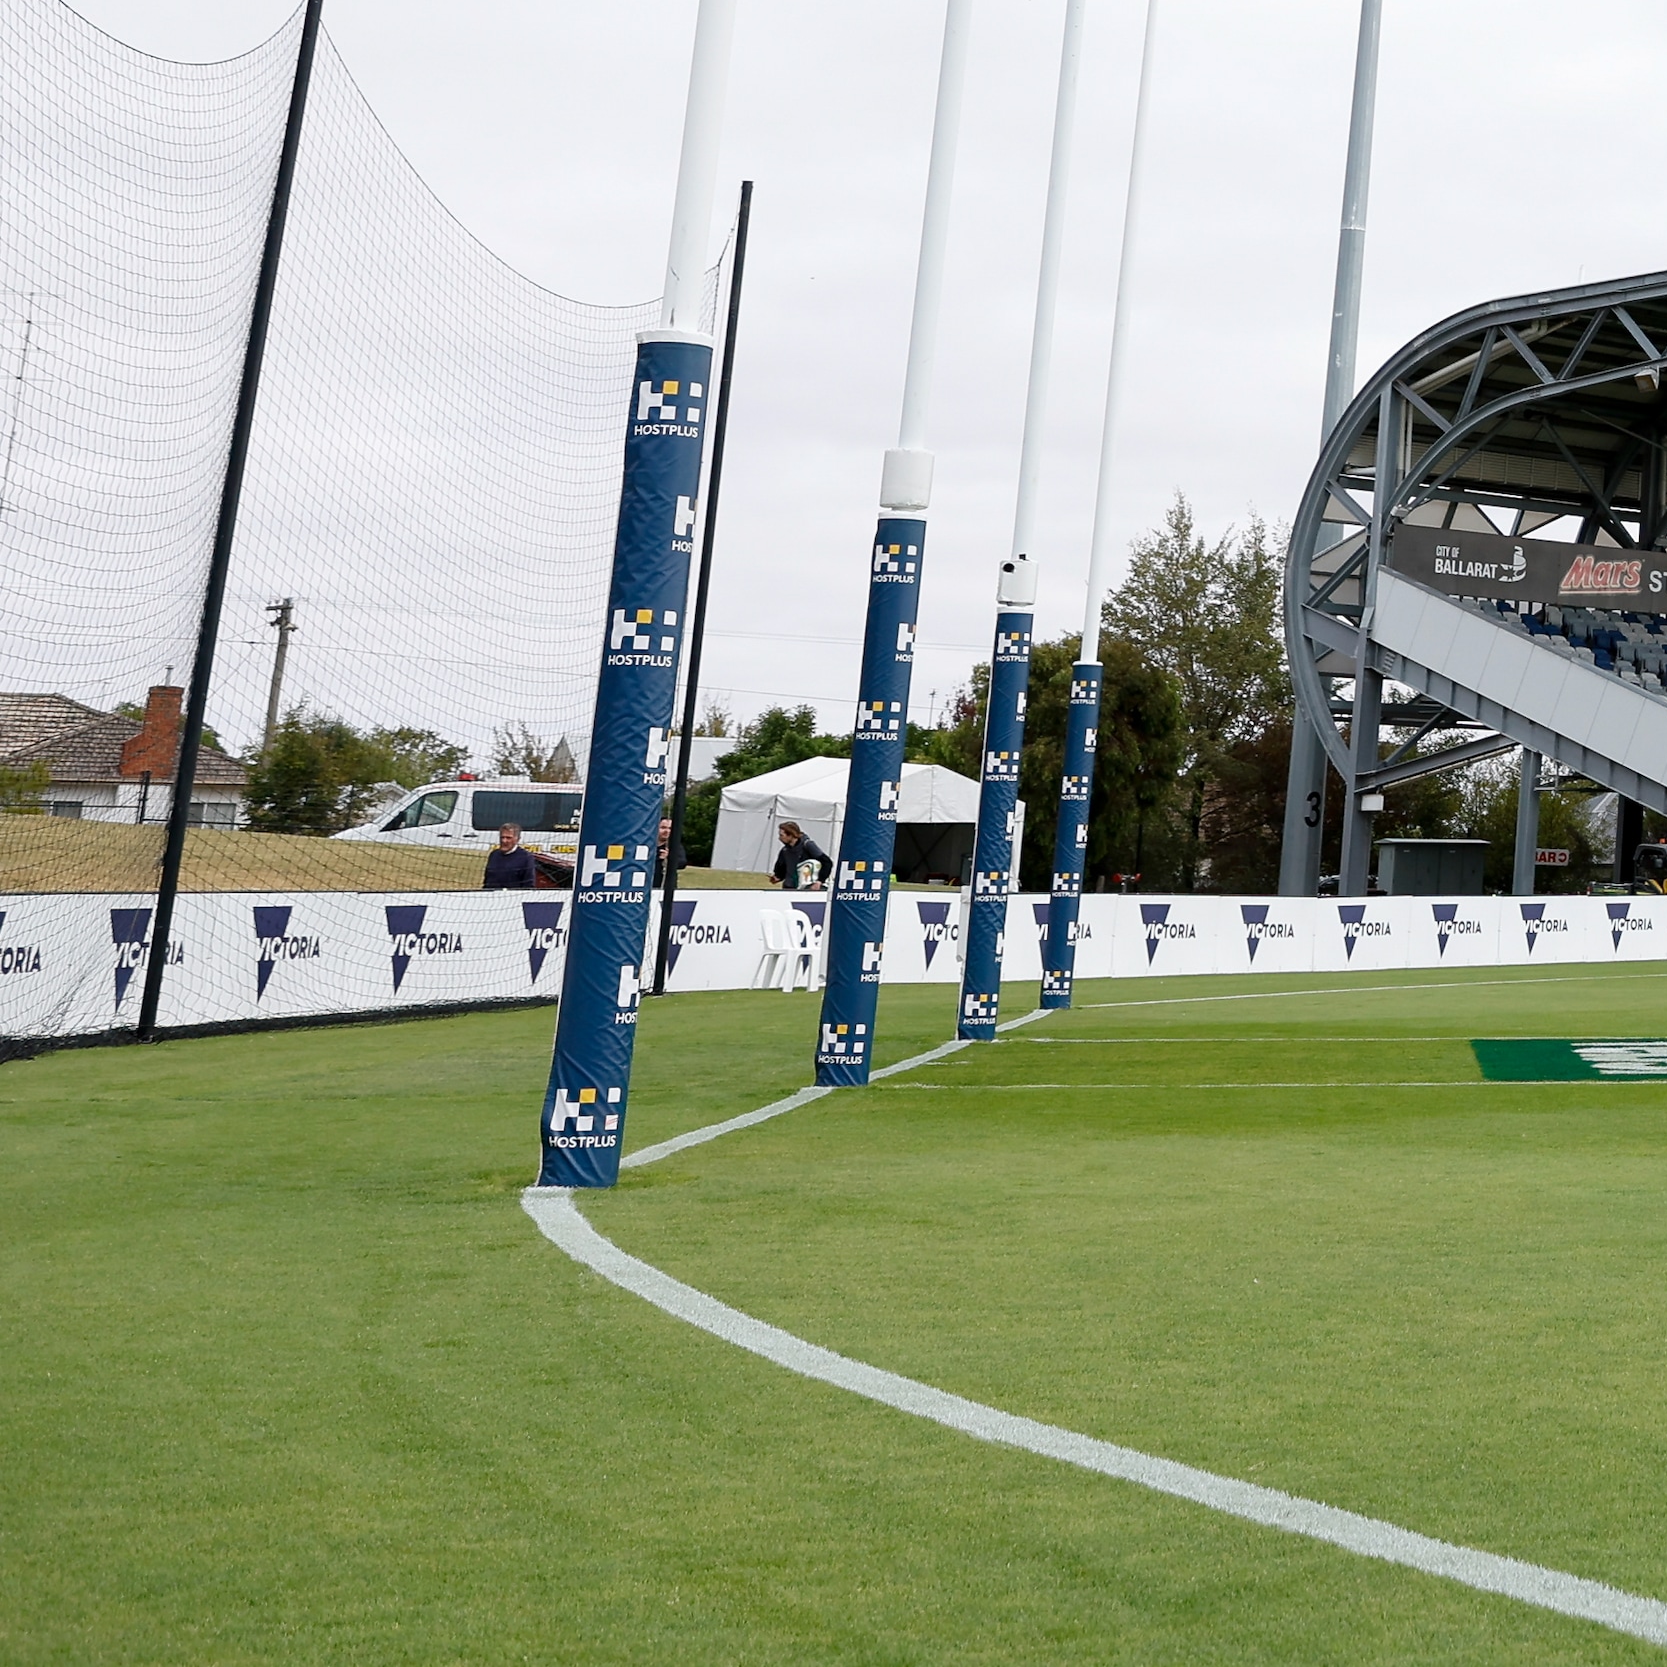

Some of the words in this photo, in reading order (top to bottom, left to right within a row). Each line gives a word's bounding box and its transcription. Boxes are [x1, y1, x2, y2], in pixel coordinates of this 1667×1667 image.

[634, 424, 698, 438] HOSTPLUS
[1436, 545, 1451, 557] CITY
[1451, 547, 1460, 558] OF
[1435, 559, 1498, 579] BALLARAT
[1561, 555, 1641, 590] Mars
[873, 574, 914, 584] HOSTPLUS
[608, 654, 672, 667] HOSTPLUS
[856, 732, 898, 741] HOSTPLUS
[1304, 791, 1321, 828] 3
[578, 891, 644, 904] HOSTPLUS
[836, 892, 881, 901] HOSTPLUS
[1143, 922, 1196, 940] VICTORIA
[1245, 922, 1294, 940] VICTORIA
[1342, 922, 1391, 938] VICTORIA
[1435, 920, 1482, 935] VICTORIA
[1522, 918, 1568, 934] VICTORIA
[1609, 918, 1653, 933] VICTORIA
[256, 935, 320, 962] VICTORIA
[388, 932, 463, 957] VICTORIA
[818, 1055, 863, 1064] HOSTPLUS
[549, 1136, 617, 1148] HOSTPLUS
